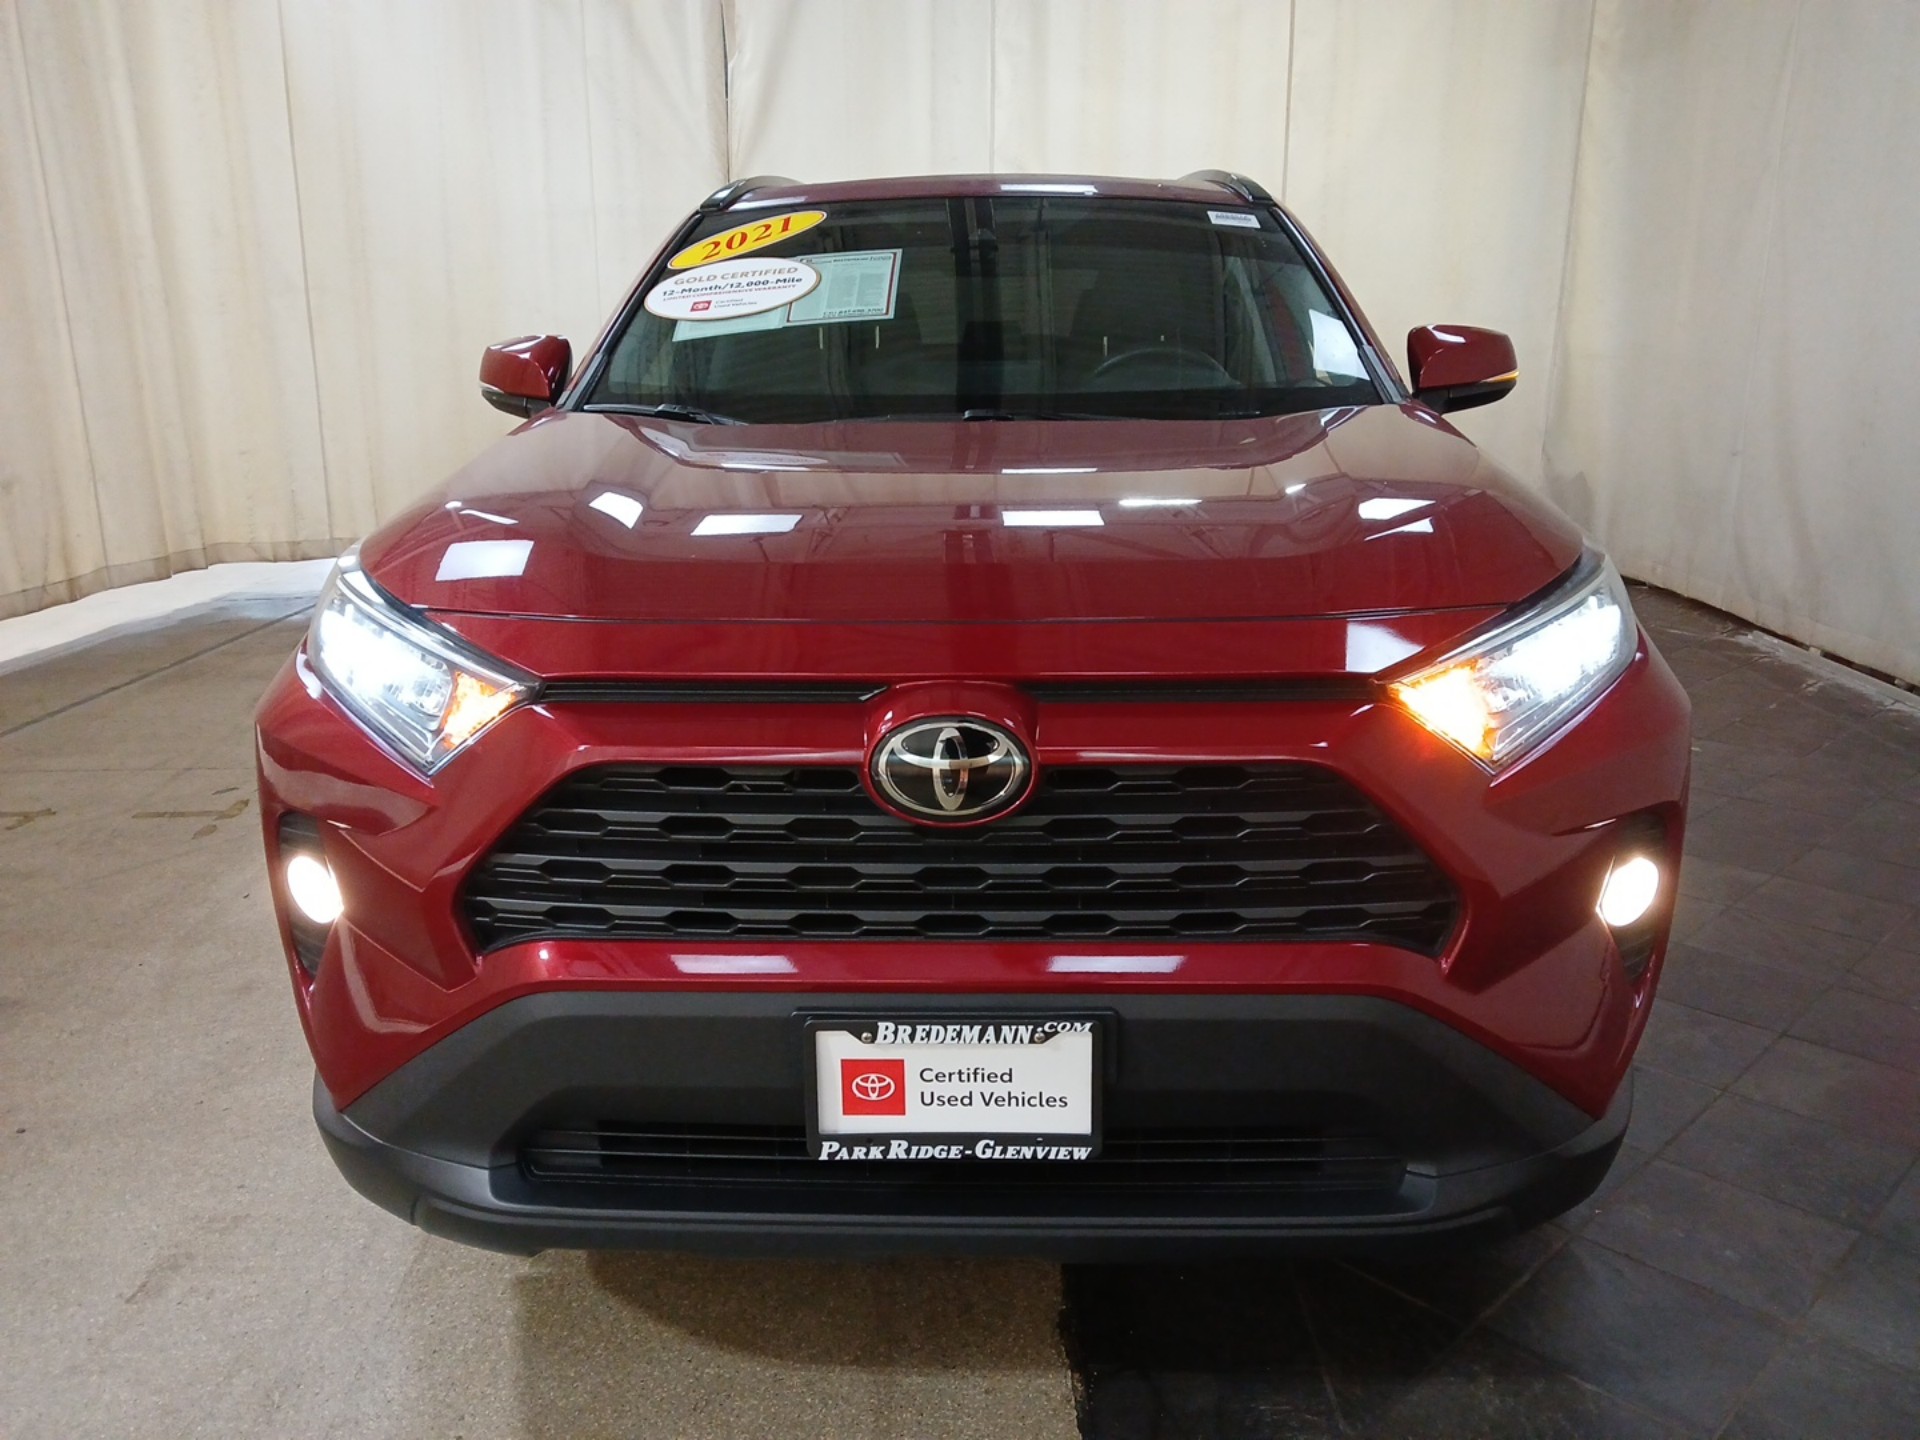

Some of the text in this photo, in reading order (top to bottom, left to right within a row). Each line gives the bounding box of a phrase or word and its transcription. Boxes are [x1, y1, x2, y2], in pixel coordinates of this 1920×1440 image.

[702, 216, 792, 260] 2021
[674, 267, 798, 285] GOLD CERTIFIED
[919, 1068, 1013, 1084] Certified
[920, 1091, 1068, 1108] Used Vehicles
[818, 1139, 1093, 1161] PARK RIDGE-GLENVIEW
